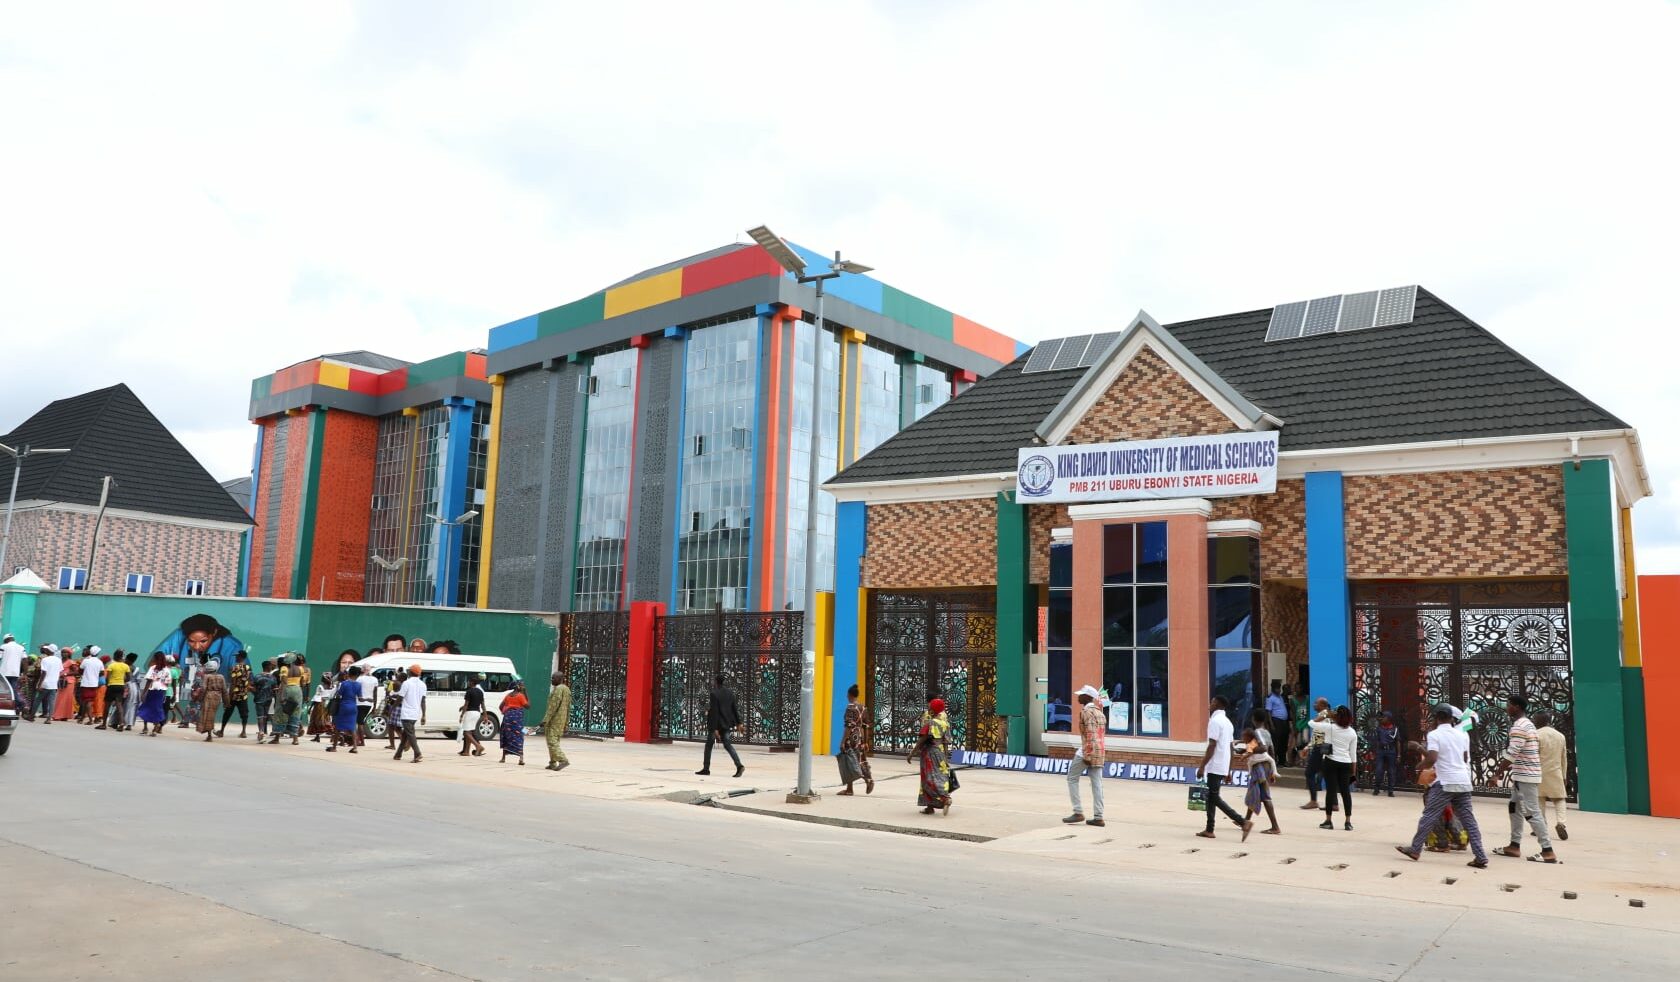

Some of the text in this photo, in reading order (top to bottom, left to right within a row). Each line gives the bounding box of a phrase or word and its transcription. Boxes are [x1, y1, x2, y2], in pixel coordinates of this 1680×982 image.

[1058, 453, 1078, 478] KING
[1081, 451, 1107, 477] DAVID
[1109, 447, 1164, 475] UNIVERSITY
[1166, 446, 1178, 472] OF
[1180, 443, 1222, 471] MEDICAL
[1225, 440, 1275, 469] SCIENCES
[1069, 472, 1258, 493] PMB 211 UBURU EBONYI STATE NIGERIA
[962, 751, 987, 765] KING
[994, 755, 1027, 769] DAVID
[1109, 763, 1125, 777] OF
[1130, 764, 1186, 781] MEDICAL
